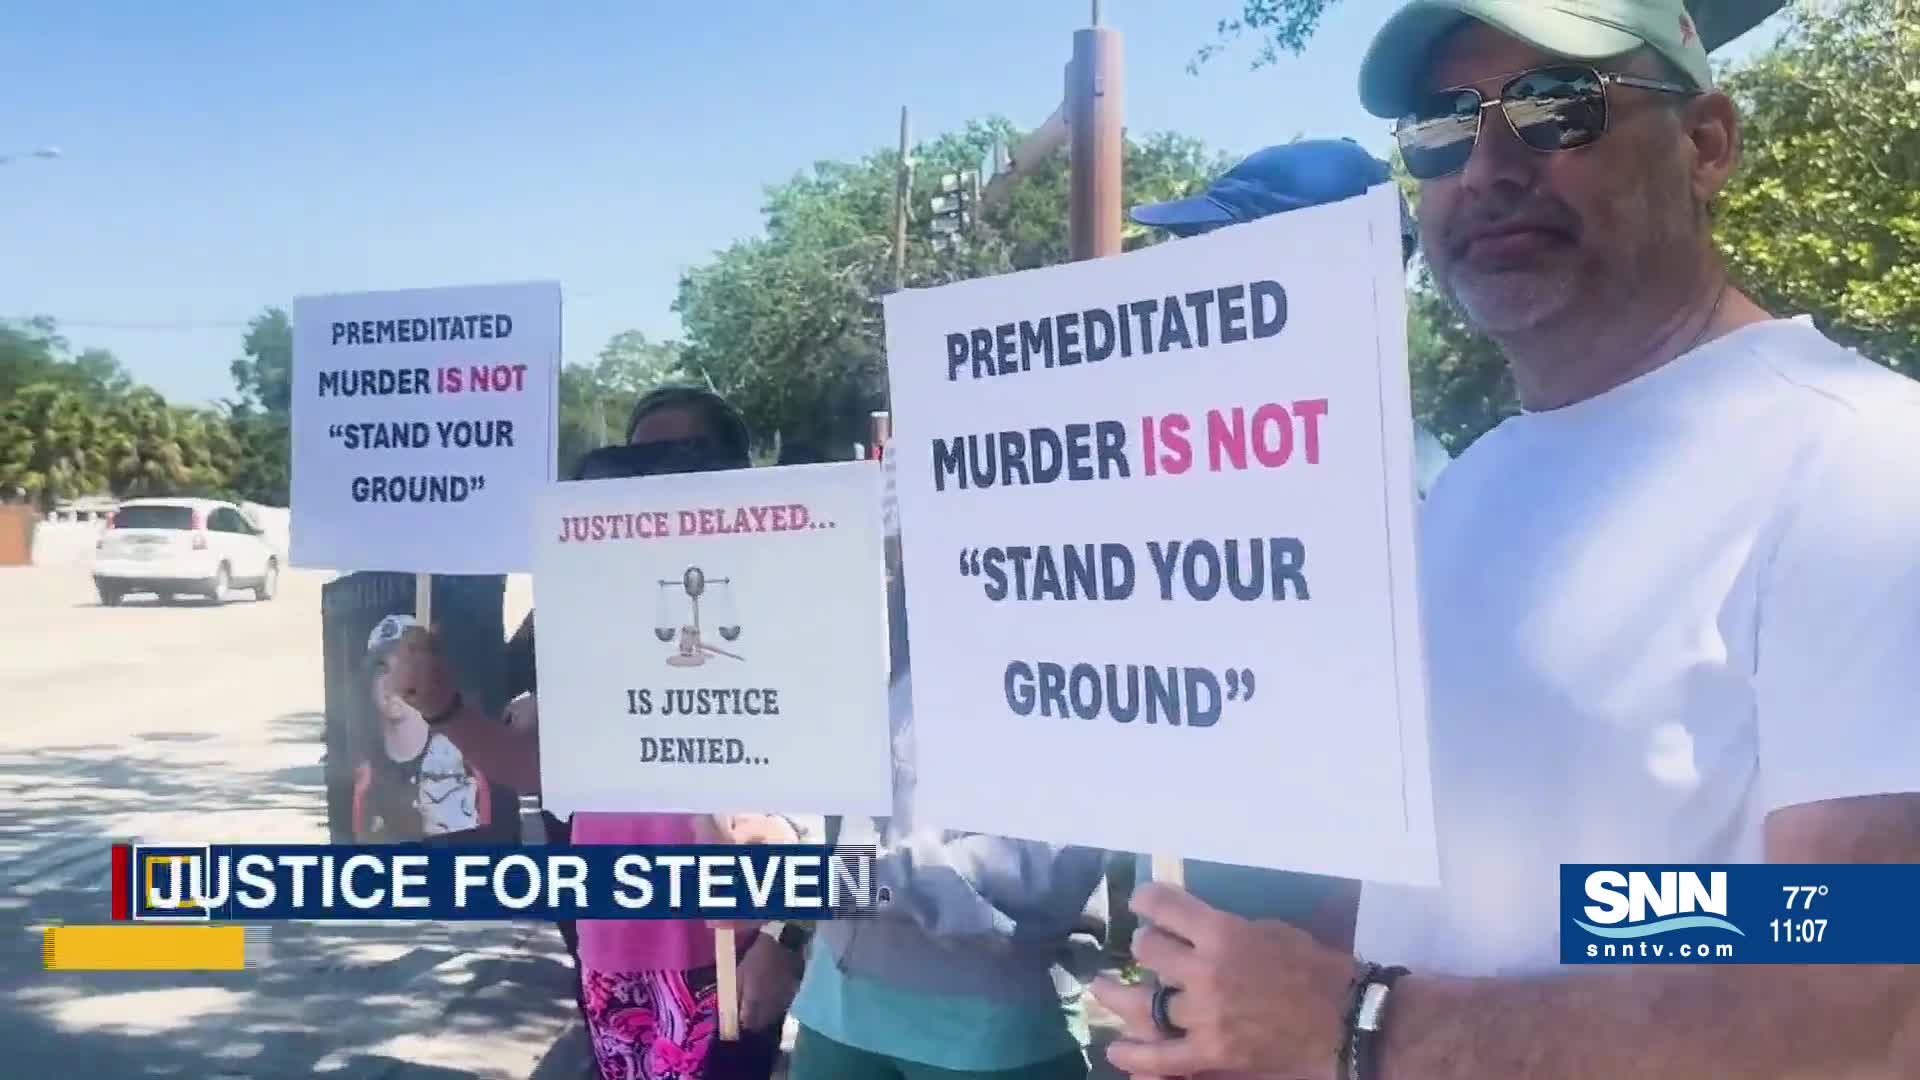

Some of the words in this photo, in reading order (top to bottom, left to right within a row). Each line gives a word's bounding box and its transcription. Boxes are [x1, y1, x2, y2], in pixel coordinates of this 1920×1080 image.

[331, 313, 513, 345] PREMEDITATED
[946, 279, 1289, 382] PREMEDITATED
[318, 366, 432, 397] MURDER
[437, 365, 463, 393] IS
[470, 363, 528, 393] NOT
[328, 422, 430, 450] “STAND
[436, 420, 515, 448] YOUR
[931, 420, 1131, 491] MURDER
[1140, 413, 1193, 476] IS
[1207, 398, 1329, 472] NOT
[351, 475, 486, 503] GROUND”
[558, 510, 670, 544] JUSTICE
[677, 503, 837, 536] DELAYED...
[959, 542, 1136, 602] “STAND
[1145, 537, 1311, 602] YOUR
[627, 688, 653, 717] IS
[660, 688, 780, 717] JUSTICE
[1003, 660, 1256, 728] GROUND”
[639, 736, 771, 767] DENIED...
